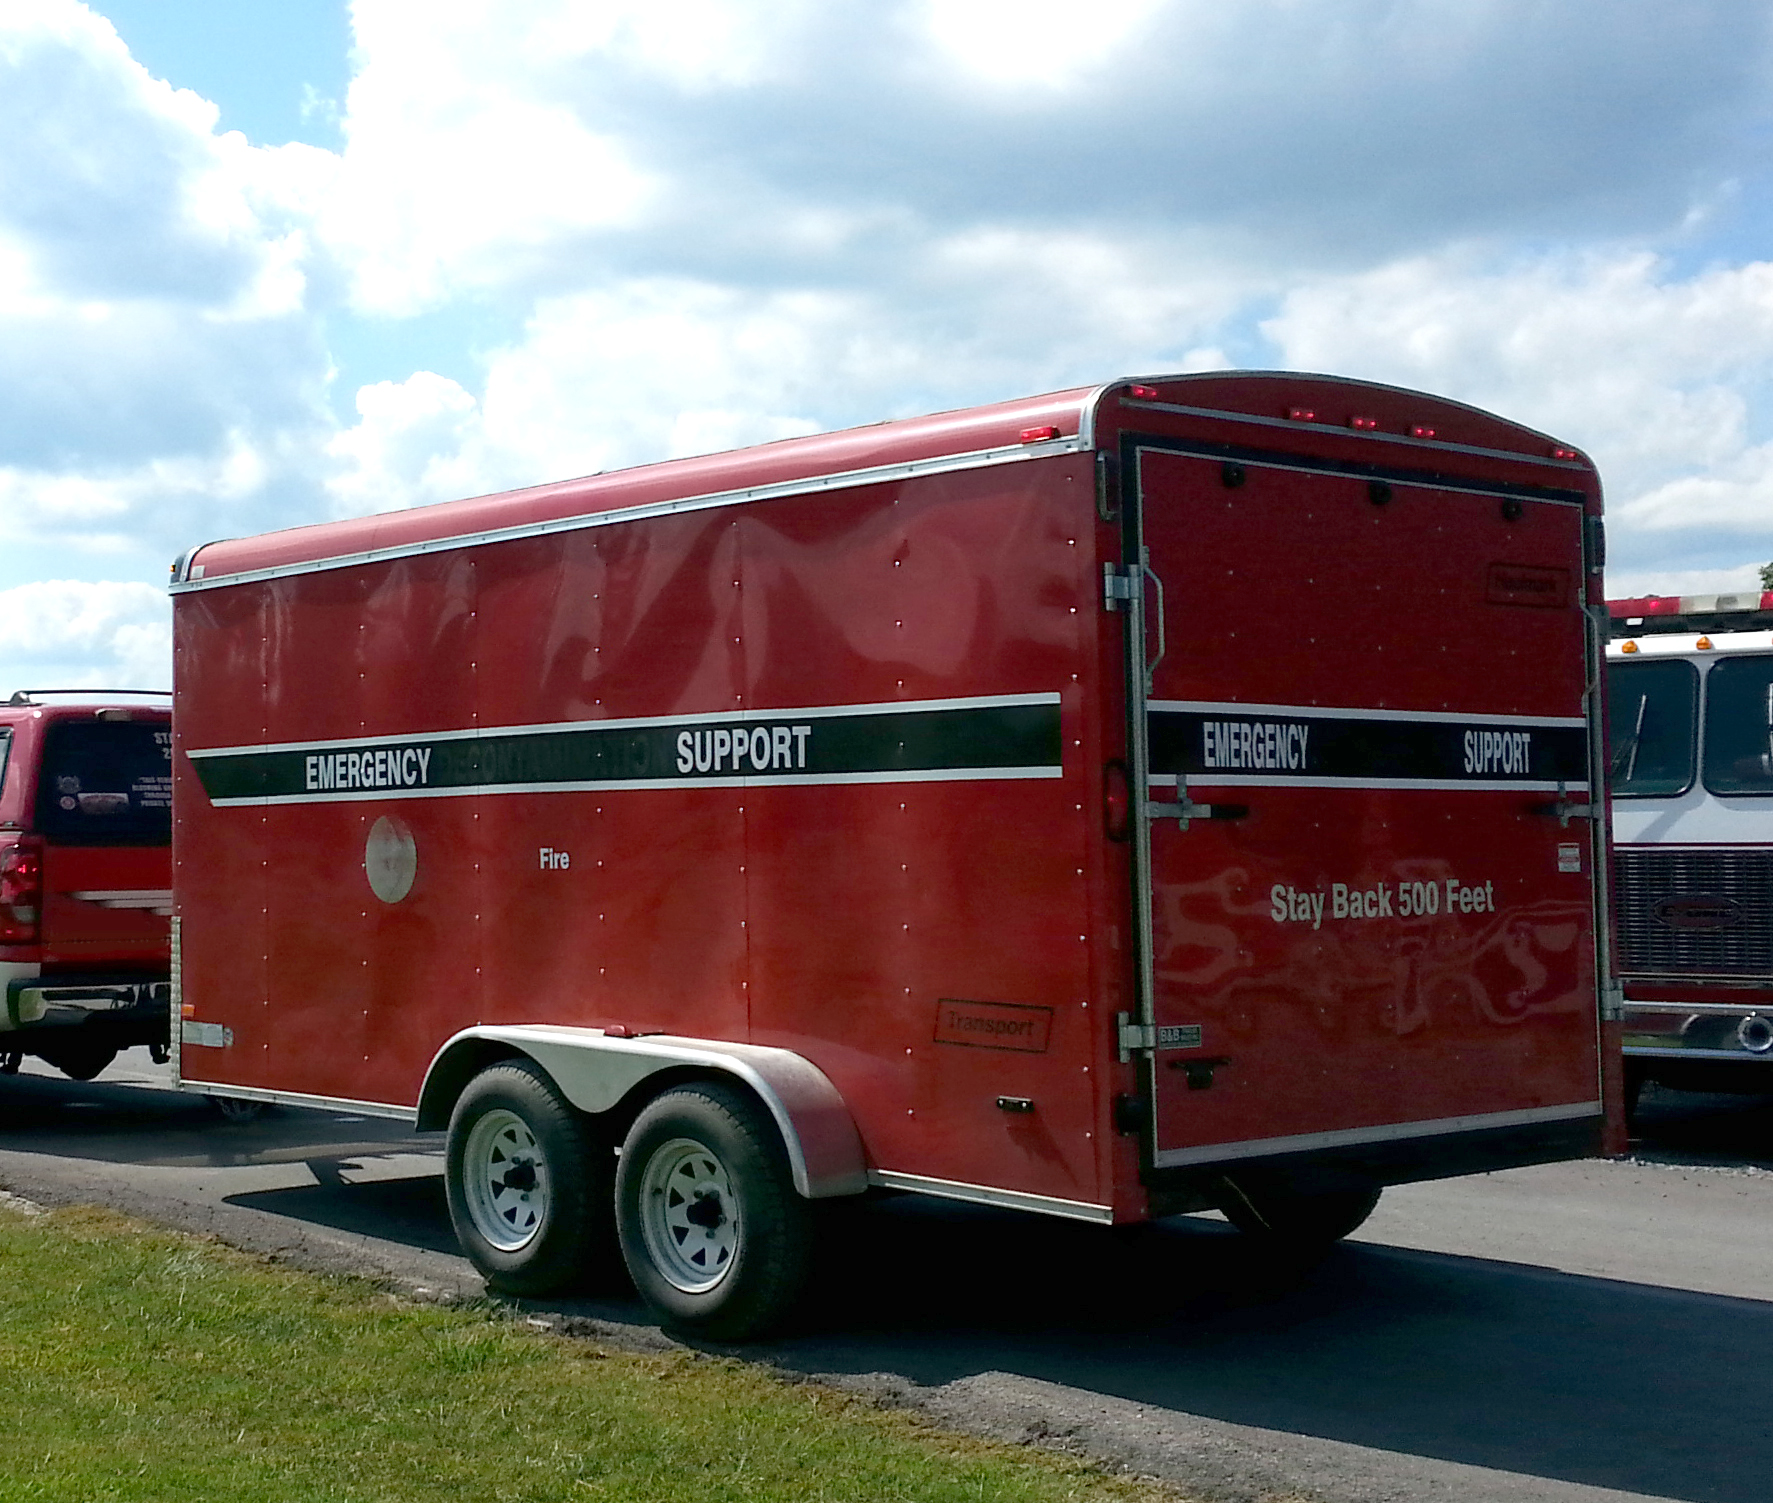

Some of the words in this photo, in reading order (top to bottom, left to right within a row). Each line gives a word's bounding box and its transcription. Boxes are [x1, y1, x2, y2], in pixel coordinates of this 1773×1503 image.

[306, 748, 431, 789] EMERGENCY
[677, 726, 811, 773] SUPPORT
[1203, 721, 1309, 770] EMERGENCY
[1464, 730, 1531, 774] SUPPORT
[539, 849, 570, 869] Fire
[1271, 884, 1324, 930] Stay
[1332, 882, 1394, 918] Back
[1399, 881, 1439, 916] 500
[1446, 879, 1495, 914] Feet
[949, 1010, 1034, 1036] Transport
